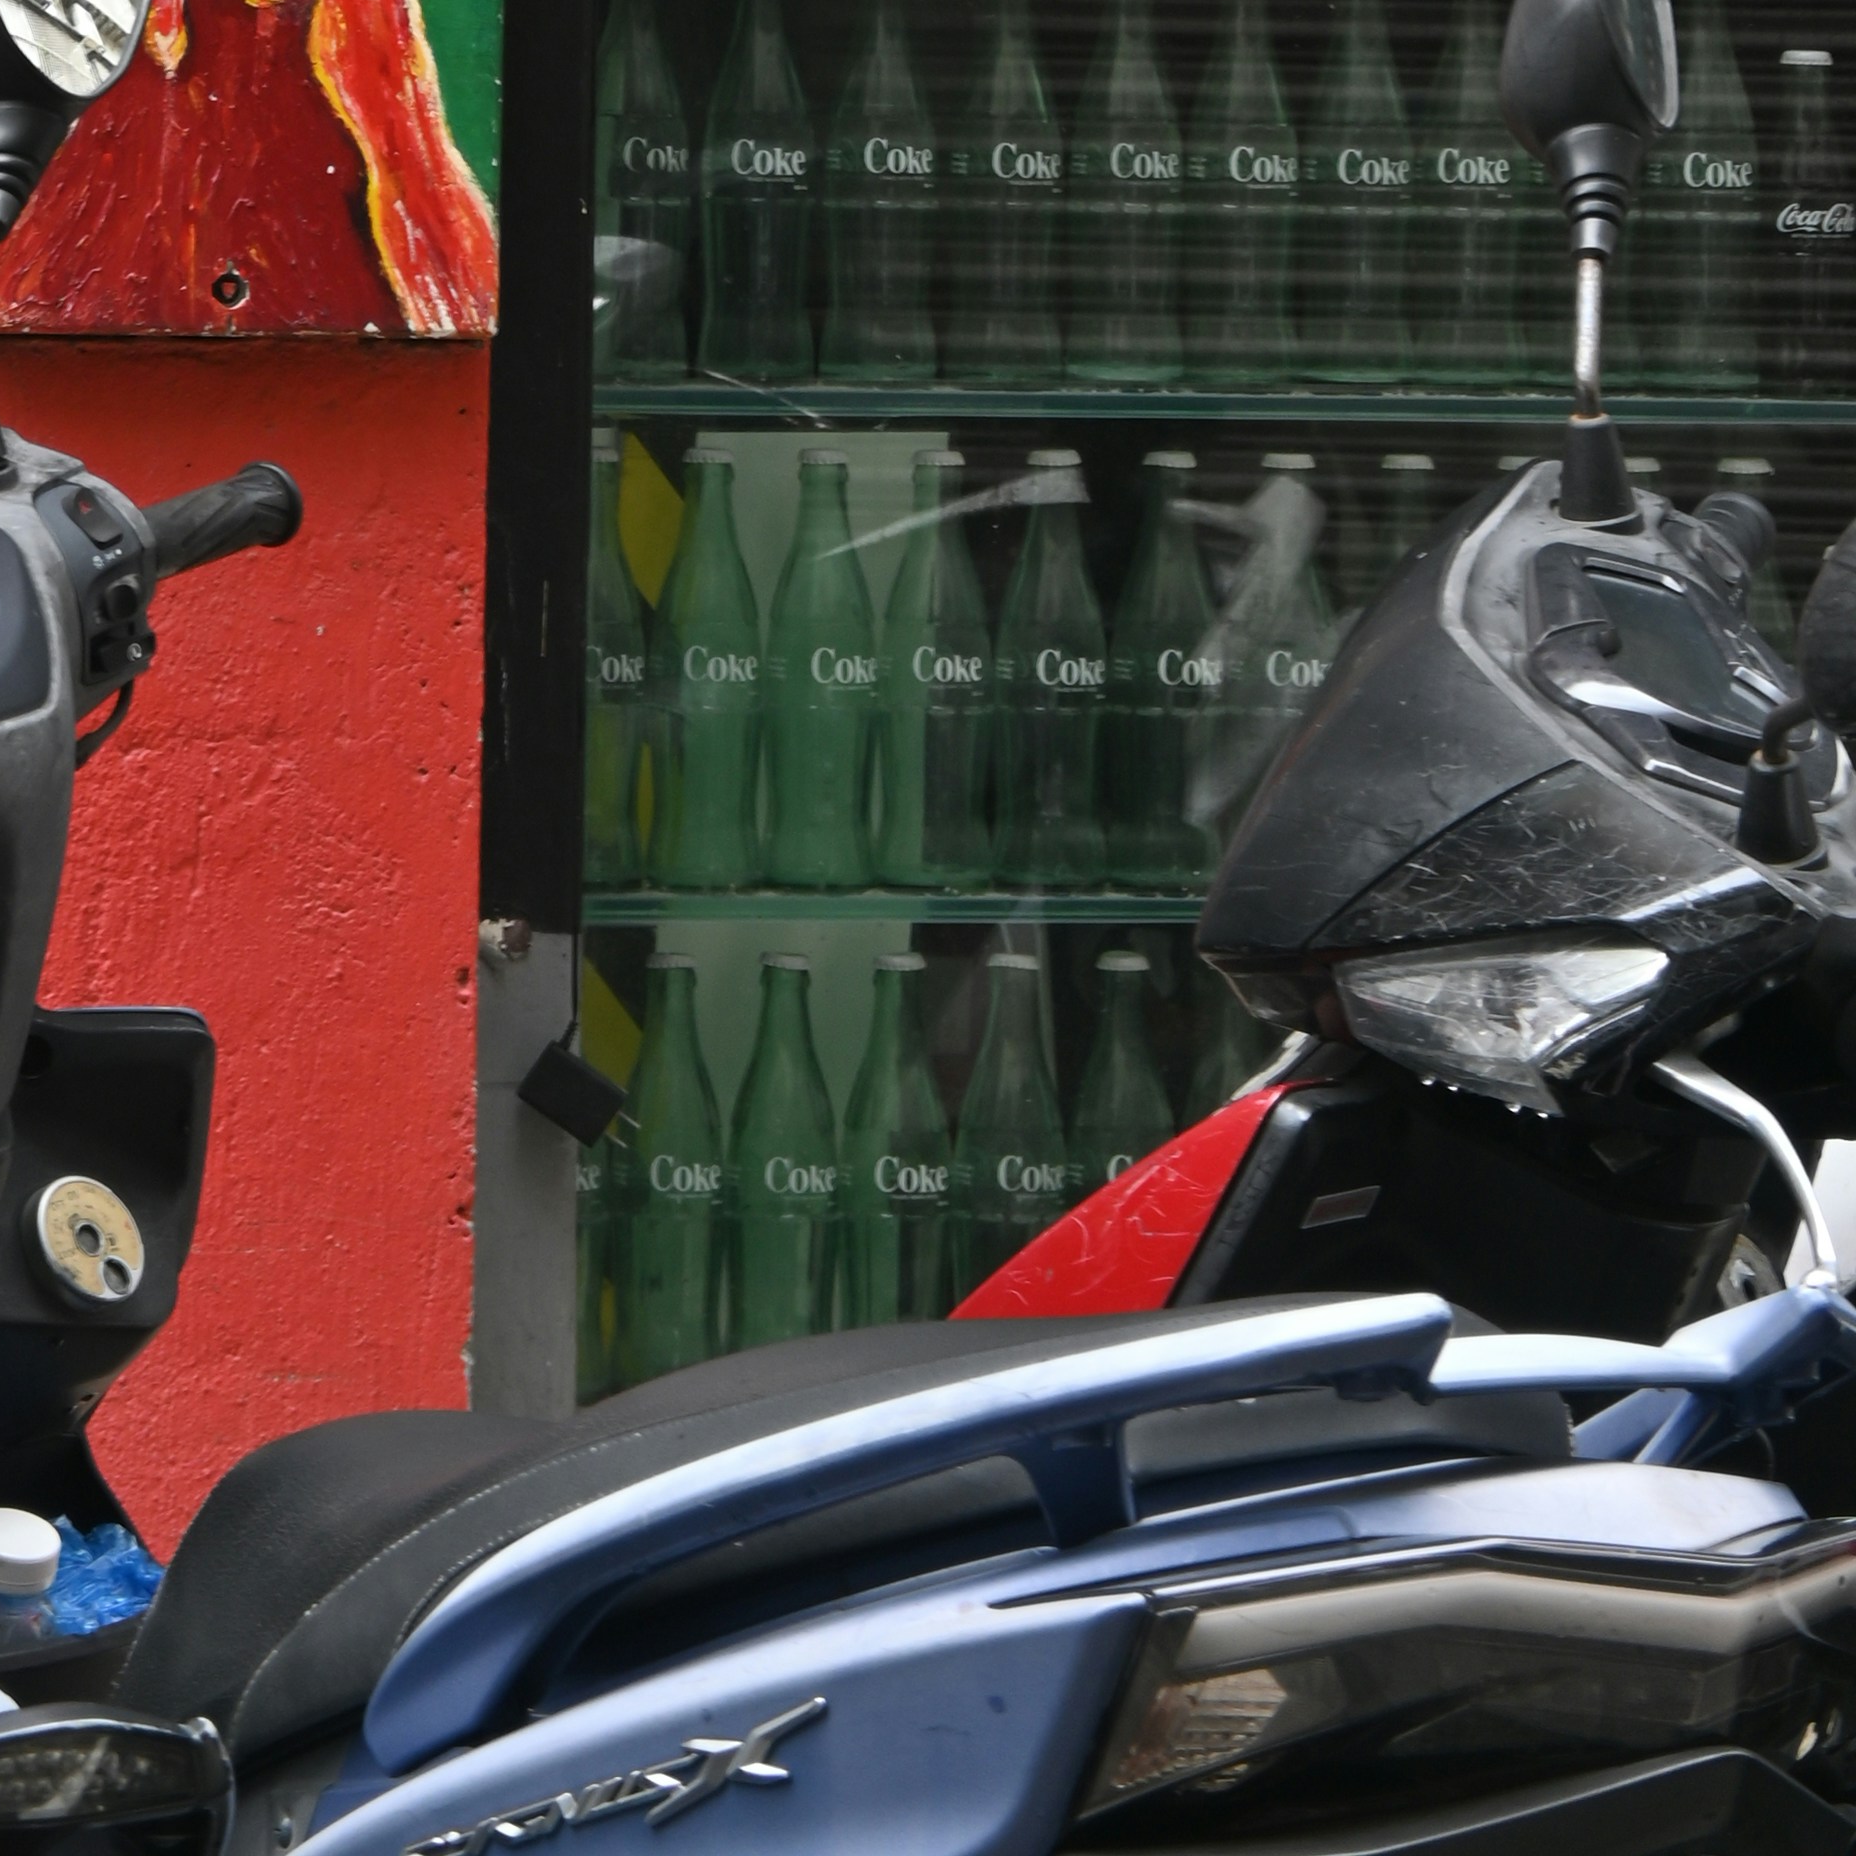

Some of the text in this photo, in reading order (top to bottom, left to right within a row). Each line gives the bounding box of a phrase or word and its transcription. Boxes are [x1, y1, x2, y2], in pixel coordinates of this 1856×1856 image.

[731, 139, 807, 176] Coke
[864, 138, 933, 174] Coke
[992, 143, 1060, 179] Coke
[1110, 143, 1179, 179] Coke
[1228, 146, 1297, 183] Coke
[1337, 149, 1409, 185] Coke
[1437, 148, 1510, 185] Coke
[1683, 152, 1753, 188] Coke
[684, 645, 757, 681] Coke
[912, 646, 982, 683] Coke
[1036, 649, 1105, 686] Coke
[1266, 650, 1332, 687] Cok
[650, 1155, 721, 1192] Coke
[764, 1156, 836, 1193] Coke
[874, 1155, 948, 1193] Coke
